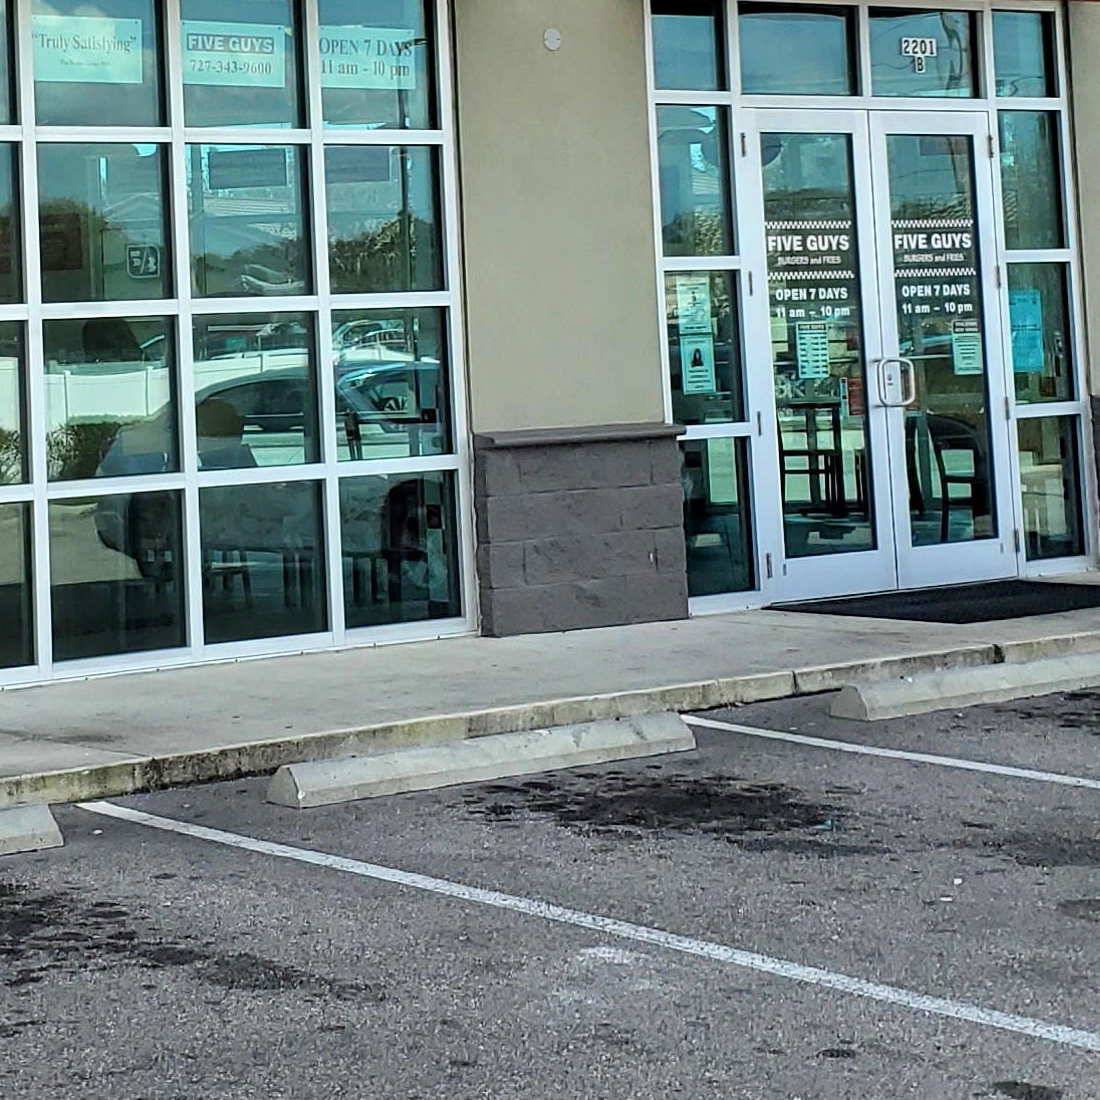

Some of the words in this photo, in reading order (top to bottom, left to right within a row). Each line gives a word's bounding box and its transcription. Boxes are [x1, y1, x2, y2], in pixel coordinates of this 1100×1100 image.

[188, 35, 224, 51] FIVE
[229, 37, 273, 53] GUYS
[319, 37, 359, 55] OPEN
[363, 39, 372, 56] 7
[376, 40, 413, 57] DAYS
[903, 40, 935, 55] 2201
[190, 59, 272, 75] 727-343-9600
[321, 59, 334, 74] 11
[338, 63, 358, 75] am
[373, 61, 385, 75] 10
[390, 64, 410, 80] pm
[916, 56, 924, 71] B
[767, 235, 803, 251] FIVE
[807, 235, 849, 251] GUYS
[894, 234, 928, 249] FIVE
[931, 233, 971, 248] GUYS
[776, 288, 807, 300] OPEN
[809, 288, 816, 300] 7
[819, 287, 848, 299] DAYS
[902, 285, 932, 297] OPEN
[934, 285, 940, 296] 7
[943, 284, 970, 295] DAYS
[776, 307, 786, 317] 11
[789, 308, 805, 317] am
[820, 306, 832, 316] 10
[834, 307, 850, 318] pm
[902, 303, 912, 314] 11
[915, 304, 930, 313] am
[944, 302, 956, 312] 10
[958, 303, 973, 314] pm
